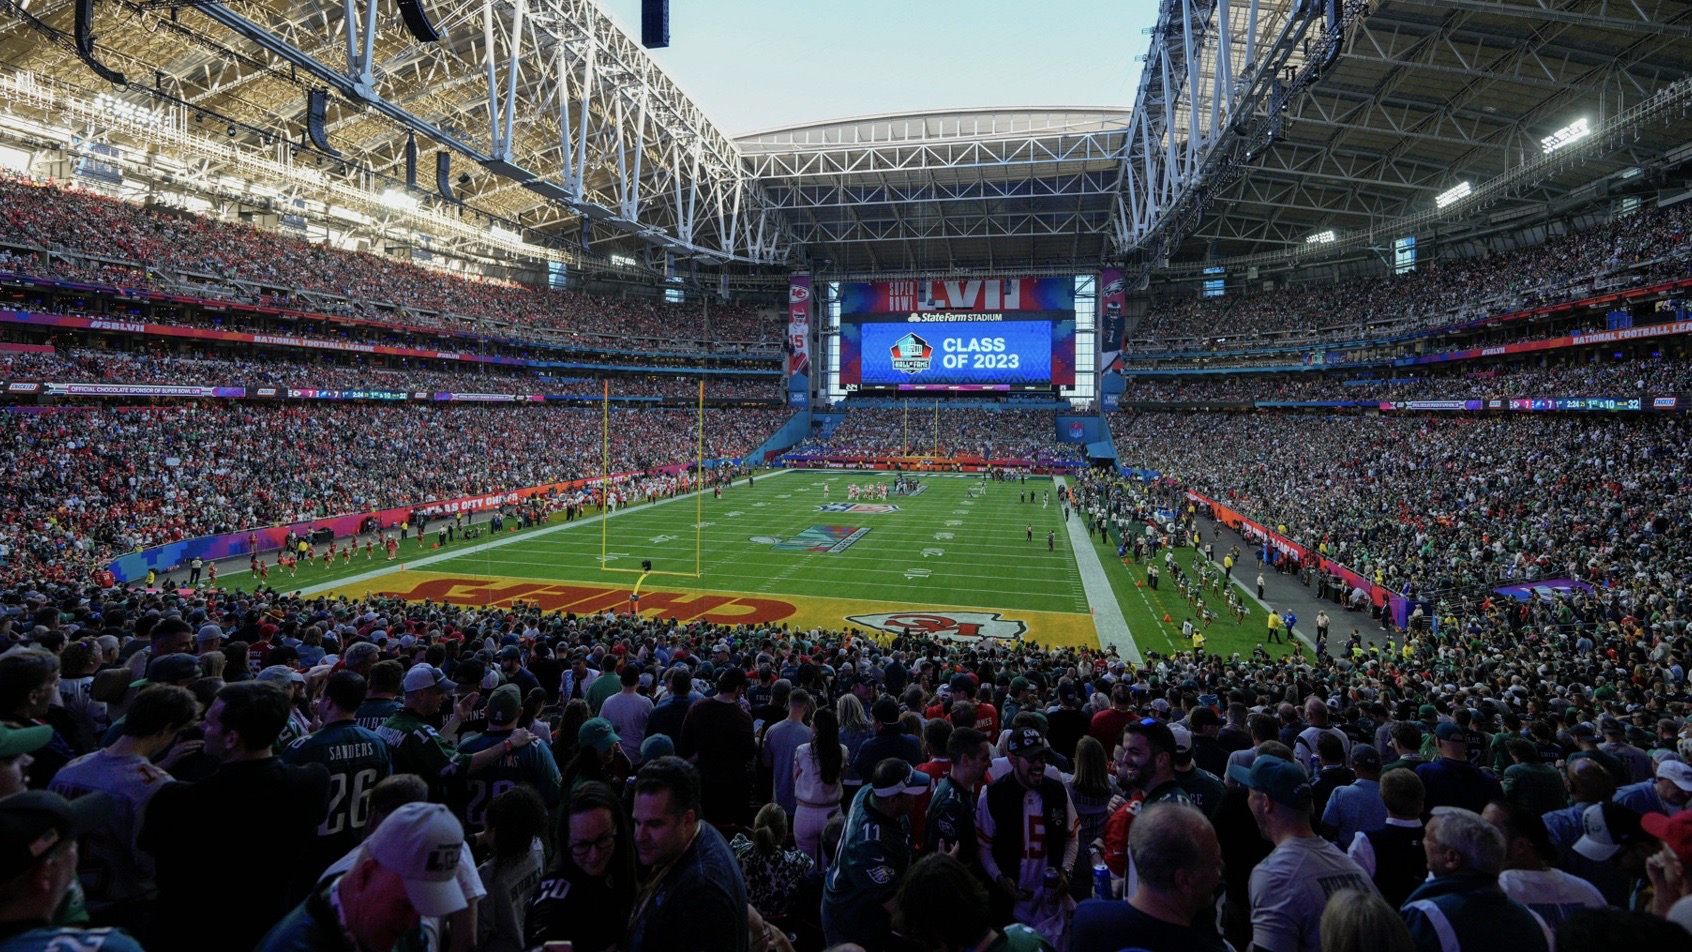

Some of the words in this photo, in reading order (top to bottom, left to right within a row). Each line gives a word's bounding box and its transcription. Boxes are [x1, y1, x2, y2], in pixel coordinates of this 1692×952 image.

[890, 281, 914, 296] SUPER
[890, 296, 914, 311] BOWL
[968, 313, 1003, 322] STADIUM
[90, 320, 145, 332] #SBLVII
[1573, 331, 1617, 344] NATIONAL
[1618, 325, 1670, 340] FOOTBALL
[254, 335, 300, 346] NATIONAL
[302, 340, 343, 350] FOOTBALL
[345, 343, 375, 352] LEAGUE
[943, 337, 1006, 352] CLASS
[943, 354, 968, 369] OF
[973, 354, 1020, 369] 2023
[1567, 400, 1580, 408] 2:24
[1605, 400, 1615, 409] 10
[1627, 400, 1639, 409] 32
[461, 498, 484, 510] CITY
[328, 742, 375, 761] SANDERS
[317, 768, 378, 836] 26
[862, 822, 882, 842] 11
